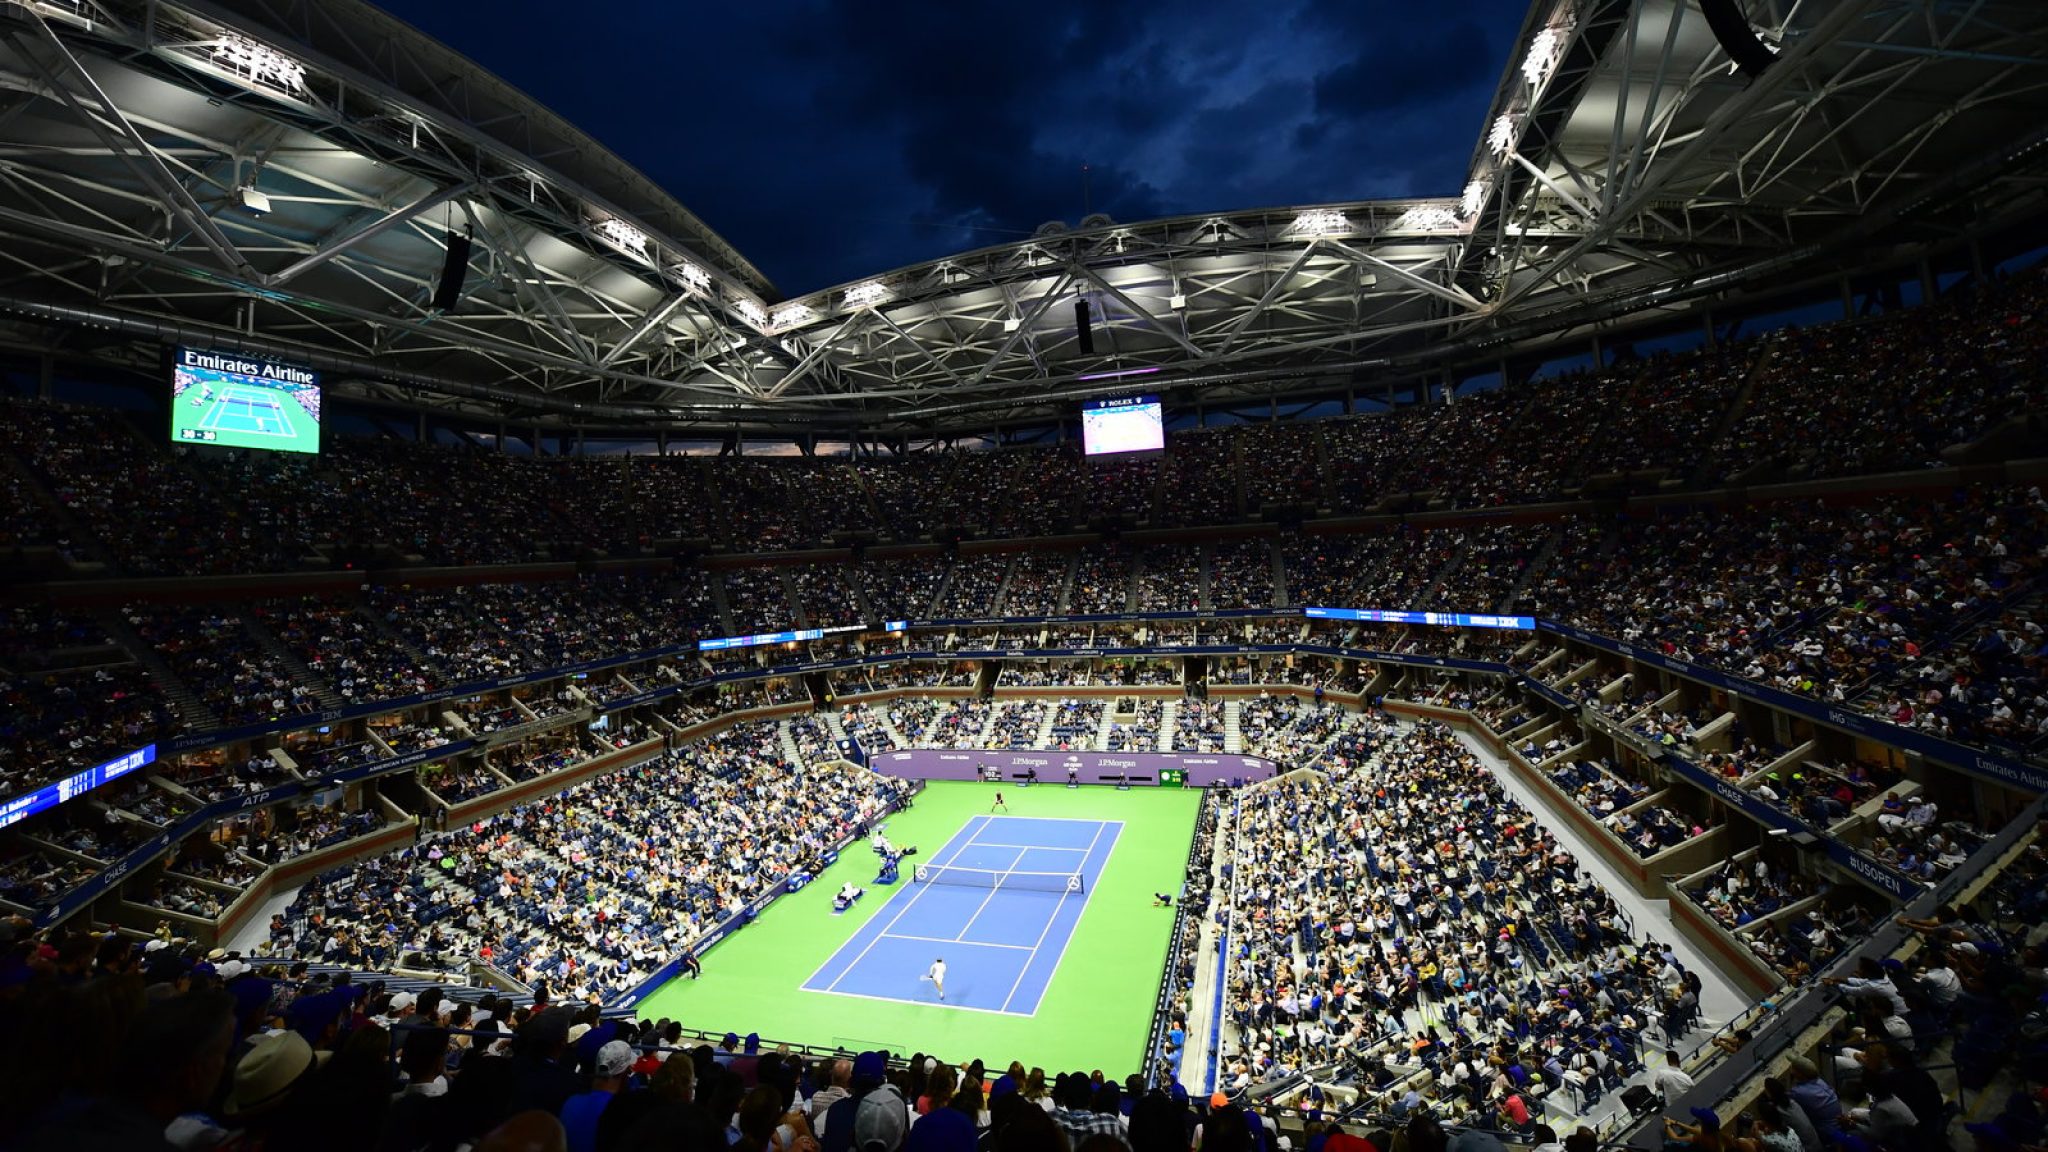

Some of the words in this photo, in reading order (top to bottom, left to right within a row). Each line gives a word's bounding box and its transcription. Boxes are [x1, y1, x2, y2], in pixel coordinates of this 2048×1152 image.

[184, 350, 259, 376] Emirates
[262, 364, 314, 384] Airline
[1828, 709, 1846, 725] IHG
[1097, 758, 1136, 769] J.P.Morgan
[1975, 757, 2018, 780] Emirates
[242, 792, 270, 808] ATP
[1716, 783, 1744, 807] CHASE
[104, 862, 128, 884] CHASE
[1849, 854, 1901, 894] #USOPEN
